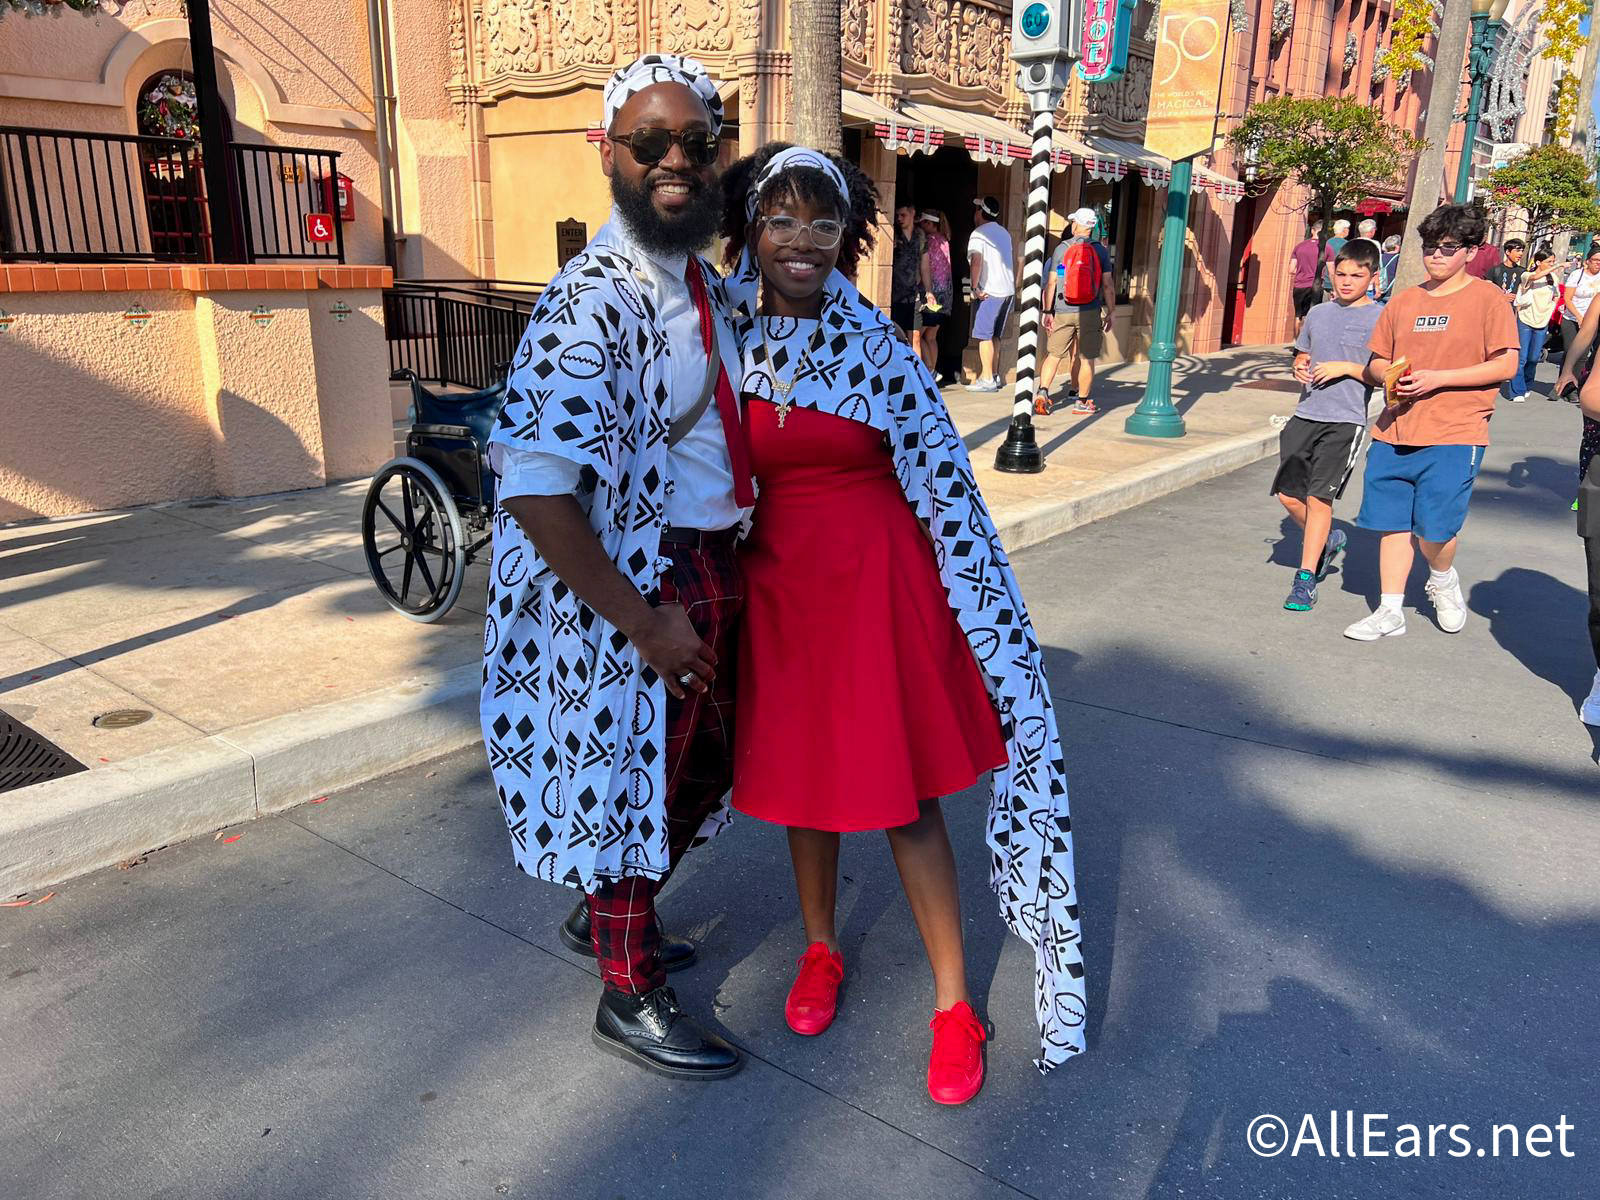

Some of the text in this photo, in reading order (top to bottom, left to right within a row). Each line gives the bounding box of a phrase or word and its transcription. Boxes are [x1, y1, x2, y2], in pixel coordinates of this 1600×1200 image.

[1025, 12, 1042, 28] GO
[1160, 14, 1220, 86] 50
[1157, 99, 1209, 110] MAGICAL
[561, 228, 583, 237] ENTER
[1417, 316, 1447, 326] NYC
